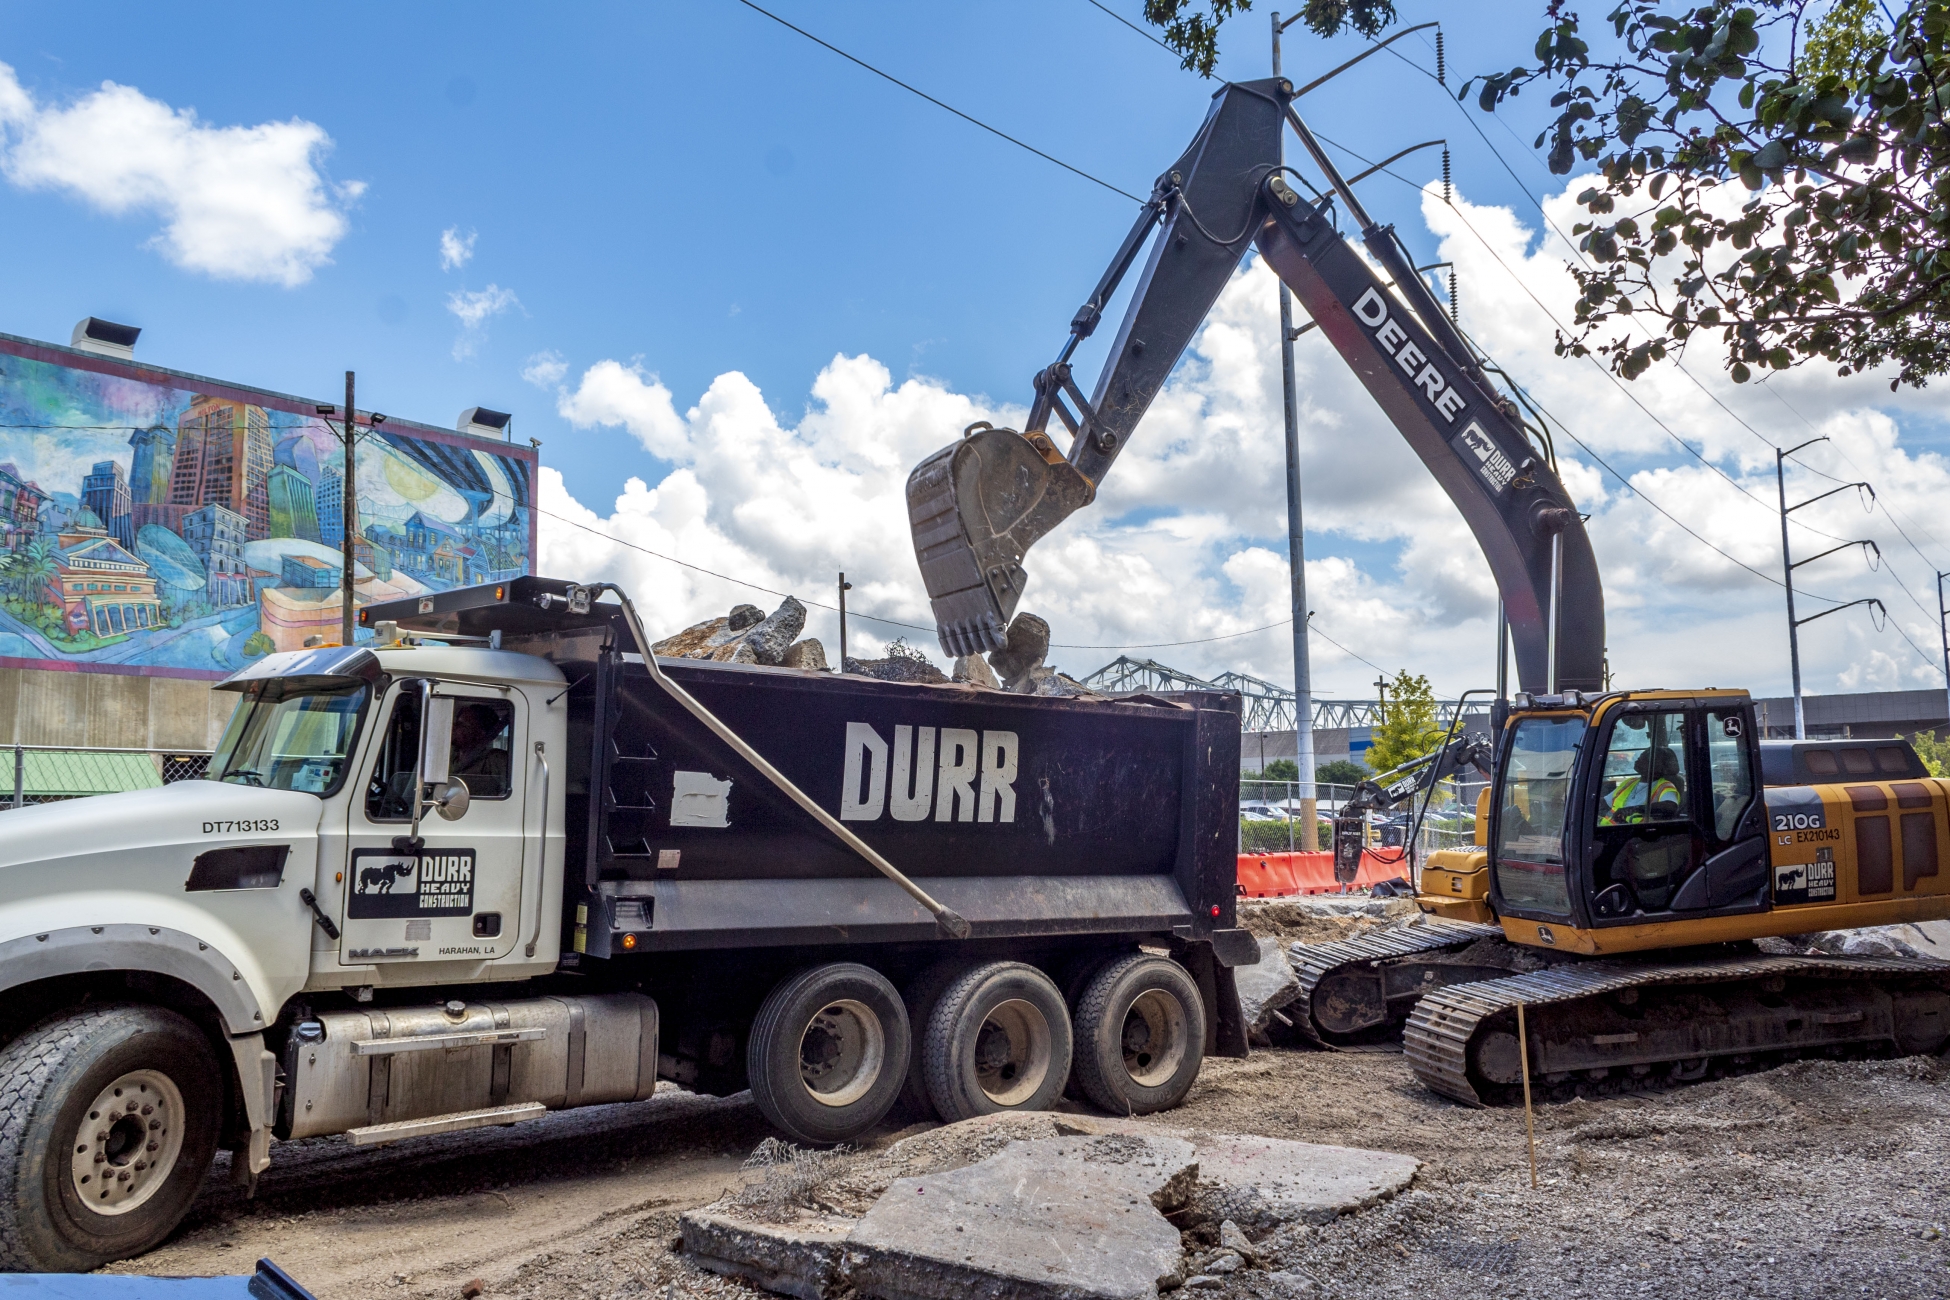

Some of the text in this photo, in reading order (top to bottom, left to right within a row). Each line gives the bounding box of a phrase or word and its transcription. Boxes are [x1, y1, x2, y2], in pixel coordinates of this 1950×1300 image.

[1351, 286, 1466, 423] DEERE
[197, 404, 220, 416] HILTON
[1485, 461, 1507, 485] HEAVY
[1489, 450, 1516, 482] DURR
[840, 721, 1019, 823] DURR
[202, 819, 279, 834] DT713133
[1775, 814, 1820, 830] 210G
[1778, 835, 1792, 845] LC
[1797, 829, 1839, 842] EX210143
[421, 856, 472, 881] DURR
[1808, 862, 1833, 879] DURR
[420, 883, 470, 893] HEAVY
[419, 894, 469, 908] CONSTRUCTION
[348, 947, 419, 958] MACK
[438, 946, 495, 955] HARAHAN, LA
